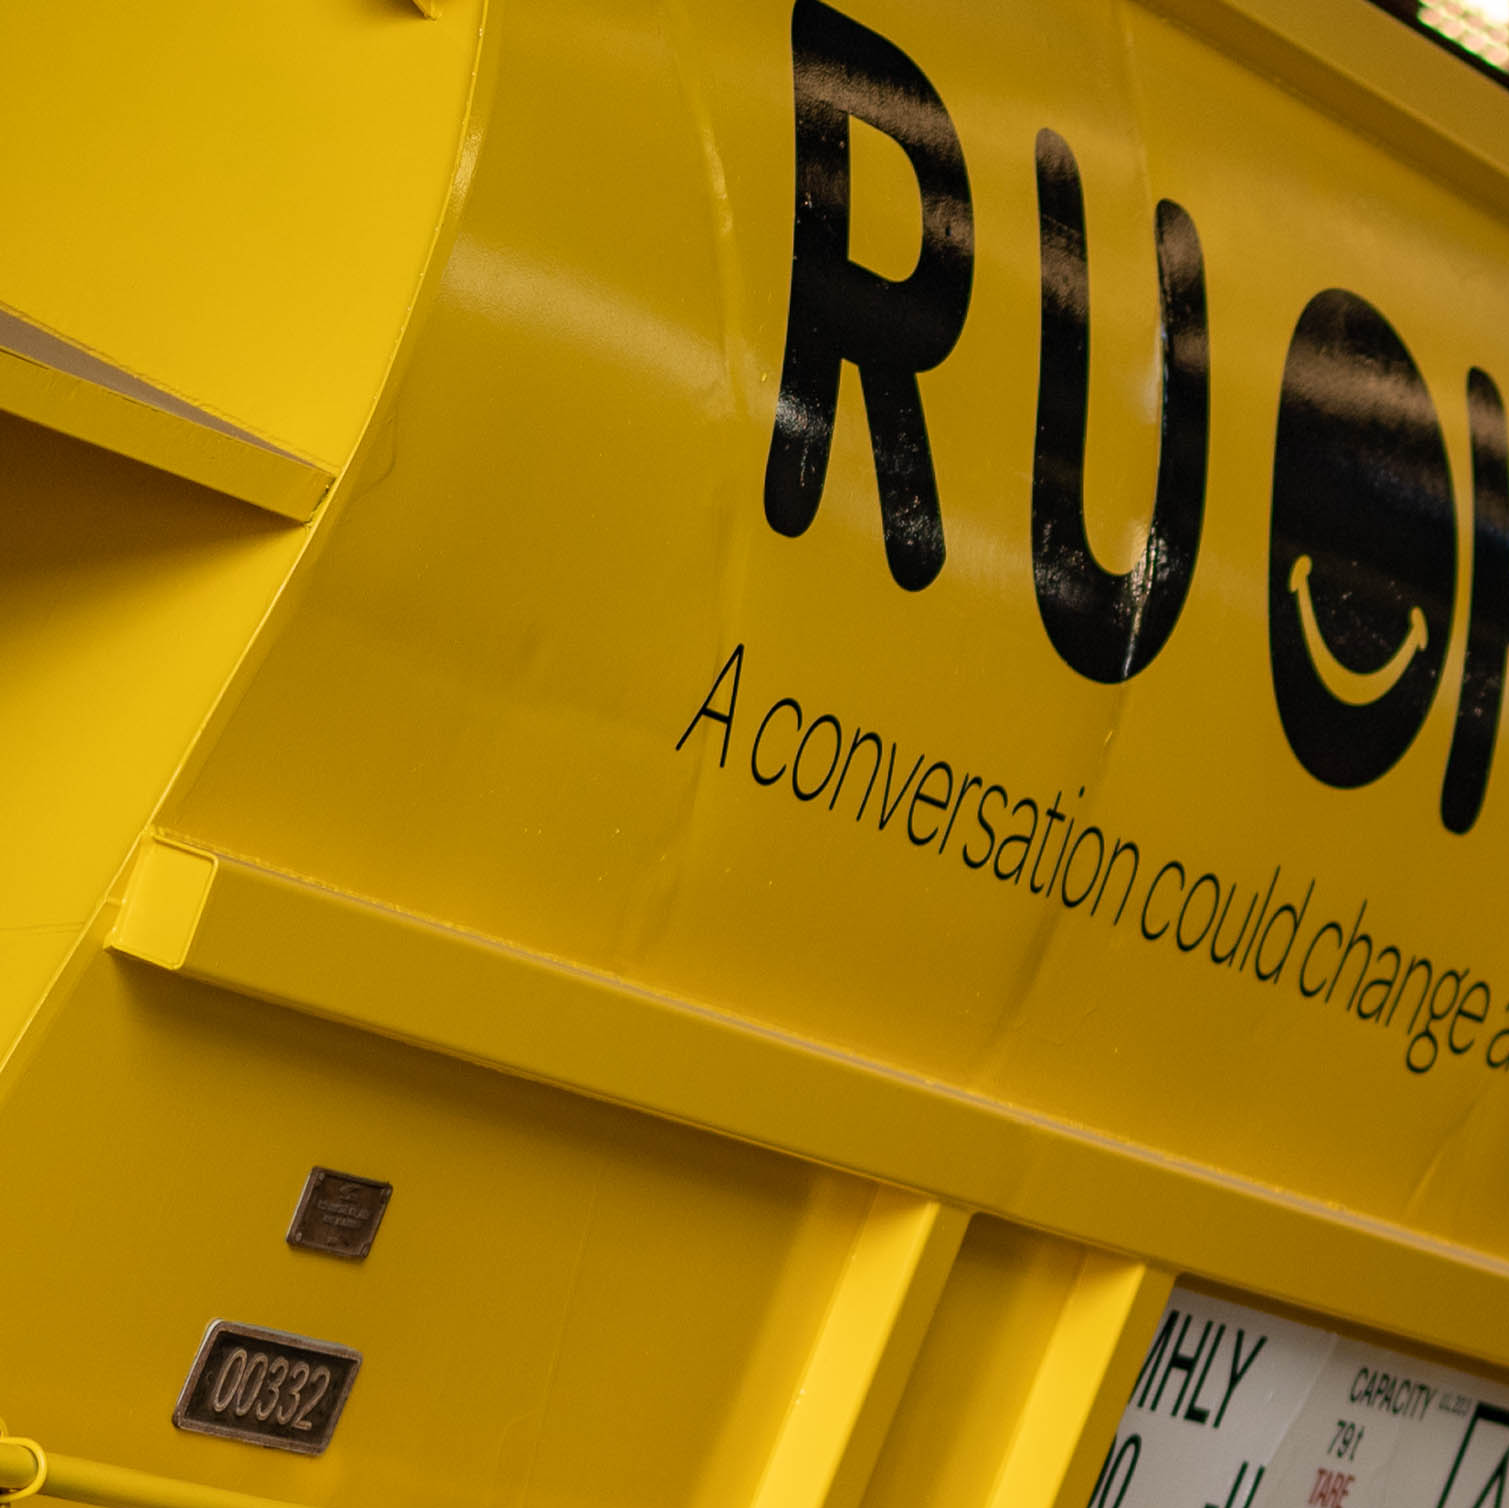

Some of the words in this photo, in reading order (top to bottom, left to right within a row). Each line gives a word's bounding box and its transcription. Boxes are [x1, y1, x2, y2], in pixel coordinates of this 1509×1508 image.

[674, 643, 745, 768] A
[750, 697, 1140, 926] conversation
[1140, 865, 1316, 985] could
[1299, 898, 1491, 1074] change
[211, 1347, 331, 1431] 00332
[1350, 1365, 1438, 1422] CAPACITY
